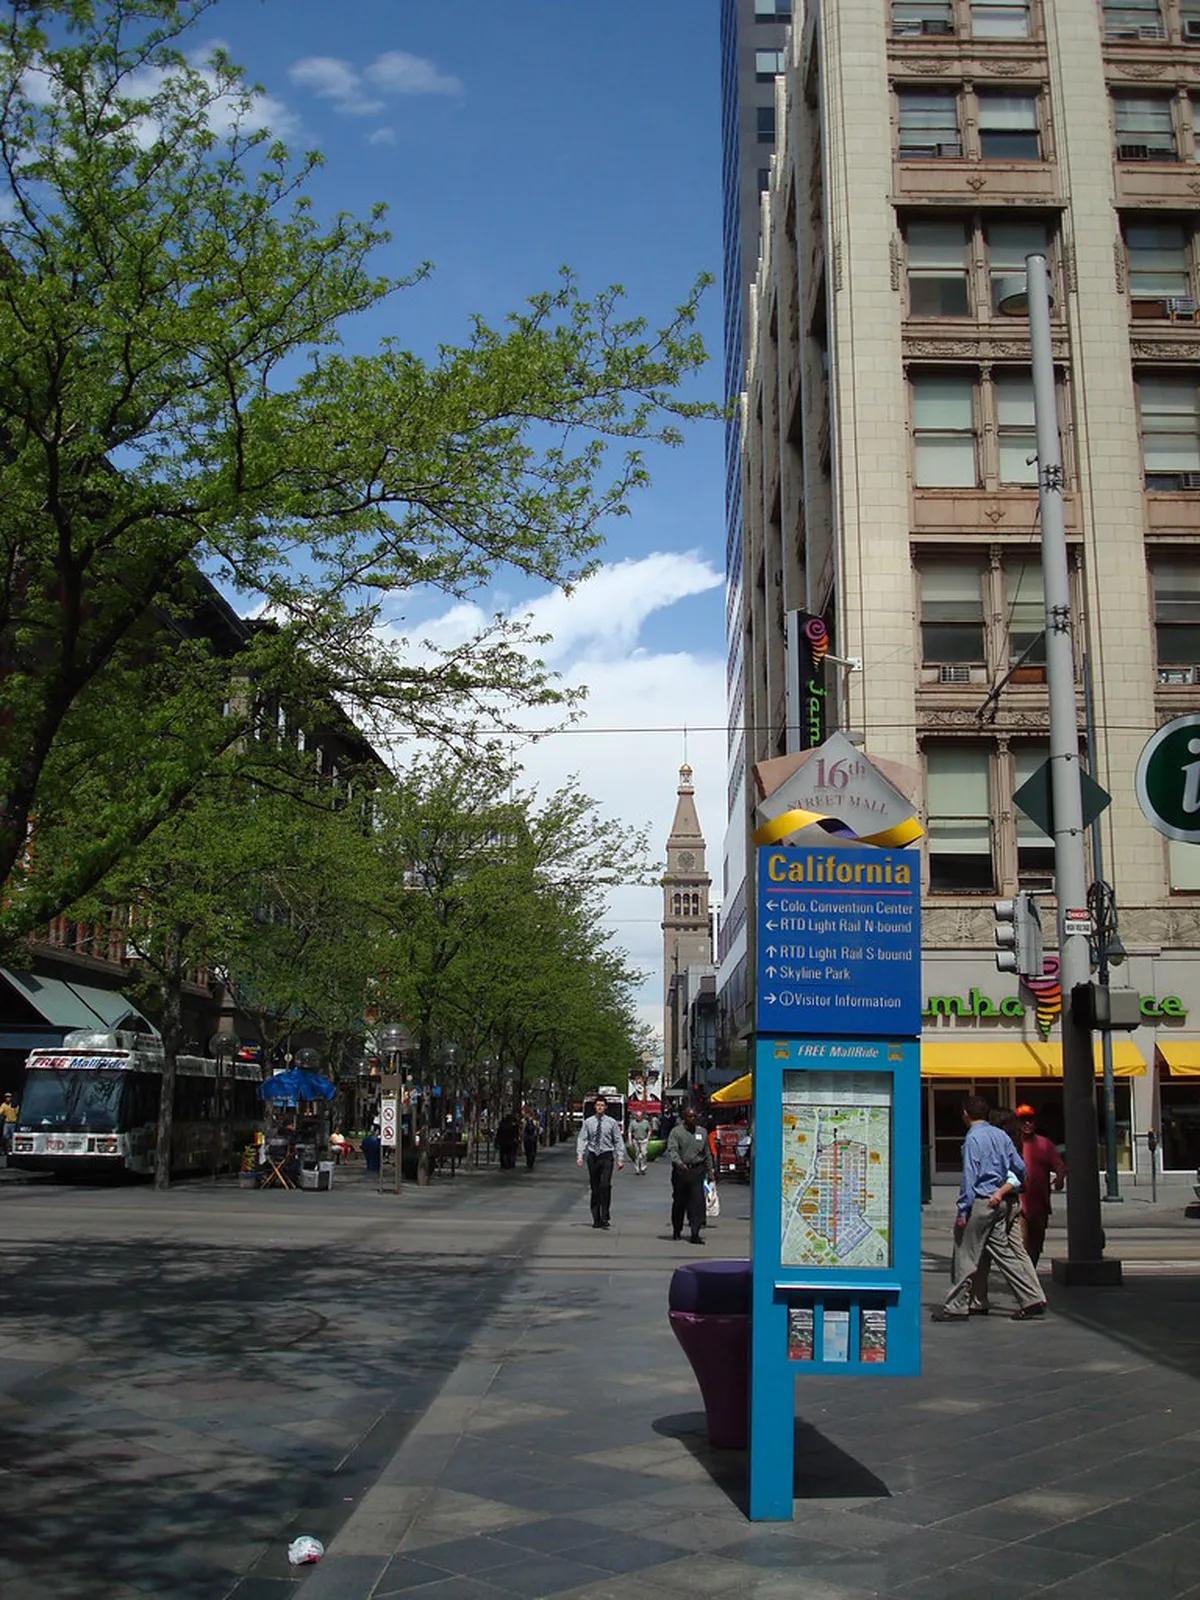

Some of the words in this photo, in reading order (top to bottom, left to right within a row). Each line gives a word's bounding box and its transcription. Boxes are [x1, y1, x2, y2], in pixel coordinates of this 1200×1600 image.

[815, 758, 866, 790] 16th
[786, 795, 844, 811] STREET
[850, 796, 889, 815] MALL
[768, 854, 911, 884] California
[810, 901, 874, 914] Convention
[876, 901, 913, 915] Center
[780, 918, 805, 931] RTD
[808, 919, 836, 933] Light
[839, 919, 860, 931] Rail
[780, 946, 805, 959] RTD
[808, 947, 836, 961] Light
[841, 947, 863, 960] Rail
[780, 966, 821, 981] Skyline
[825, 967, 850, 980] Park
[794, 993, 831, 1006] Visitor
[835, 994, 901, 1008] Information
[921, 987, 1024, 1017] mba
[798, 1045, 826, 1057] FREE
[829, 1046, 879, 1058] MallRide
[31, 1057, 68, 1068] FREE
